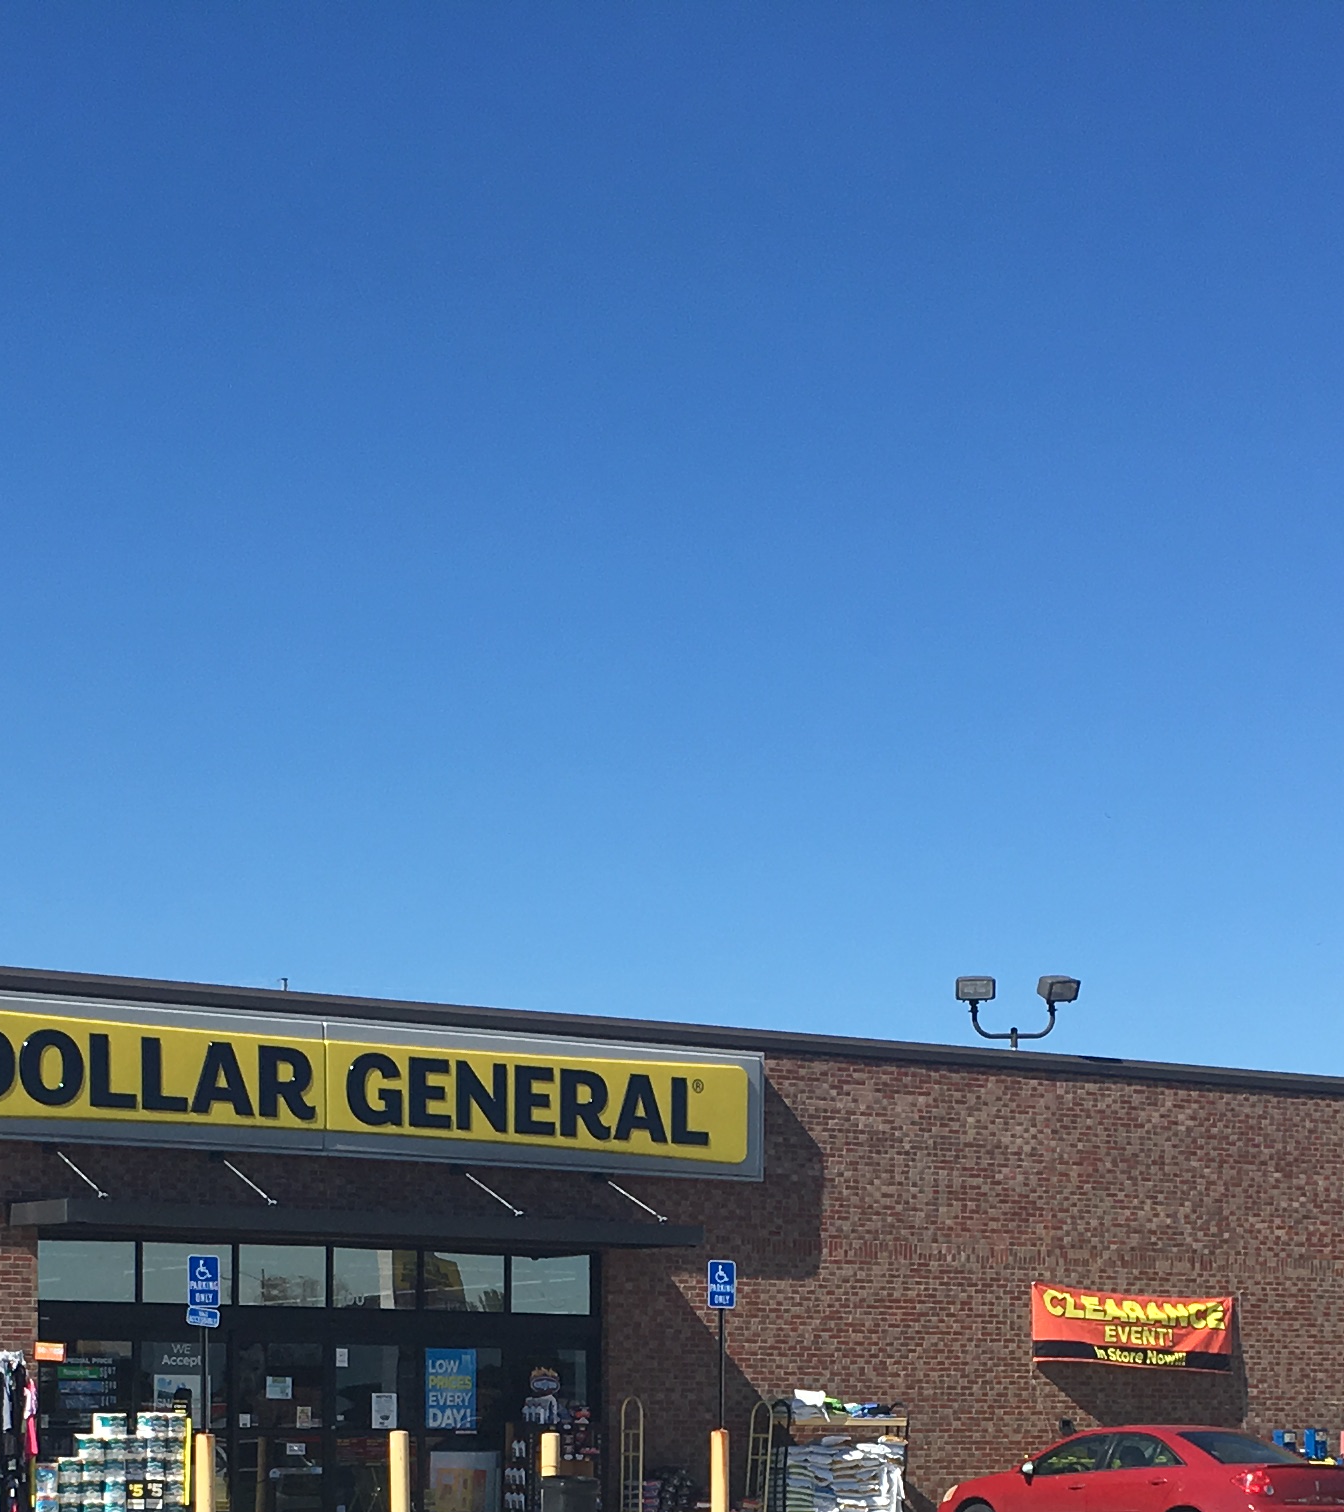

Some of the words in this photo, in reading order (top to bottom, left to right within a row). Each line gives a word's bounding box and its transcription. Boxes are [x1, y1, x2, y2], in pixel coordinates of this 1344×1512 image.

[346, 1051, 710, 1146] GENERAL
[195, 1293, 213, 1303] ONLY
[1042, 1289, 1226, 1330] CLEARANCE
[1104, 1325, 1173, 1347] EVENT!
[171, 1343, 192, 1354] WE
[1109, 1348, 1143, 1364] Store
[162, 1354, 202, 1368] Accept
[428, 1359, 459, 1373] LOW
[428, 1375, 472, 1390] PRICES
[428, 1391, 472, 1406] EVERY
[428, 1407, 471, 1428] DAY!
